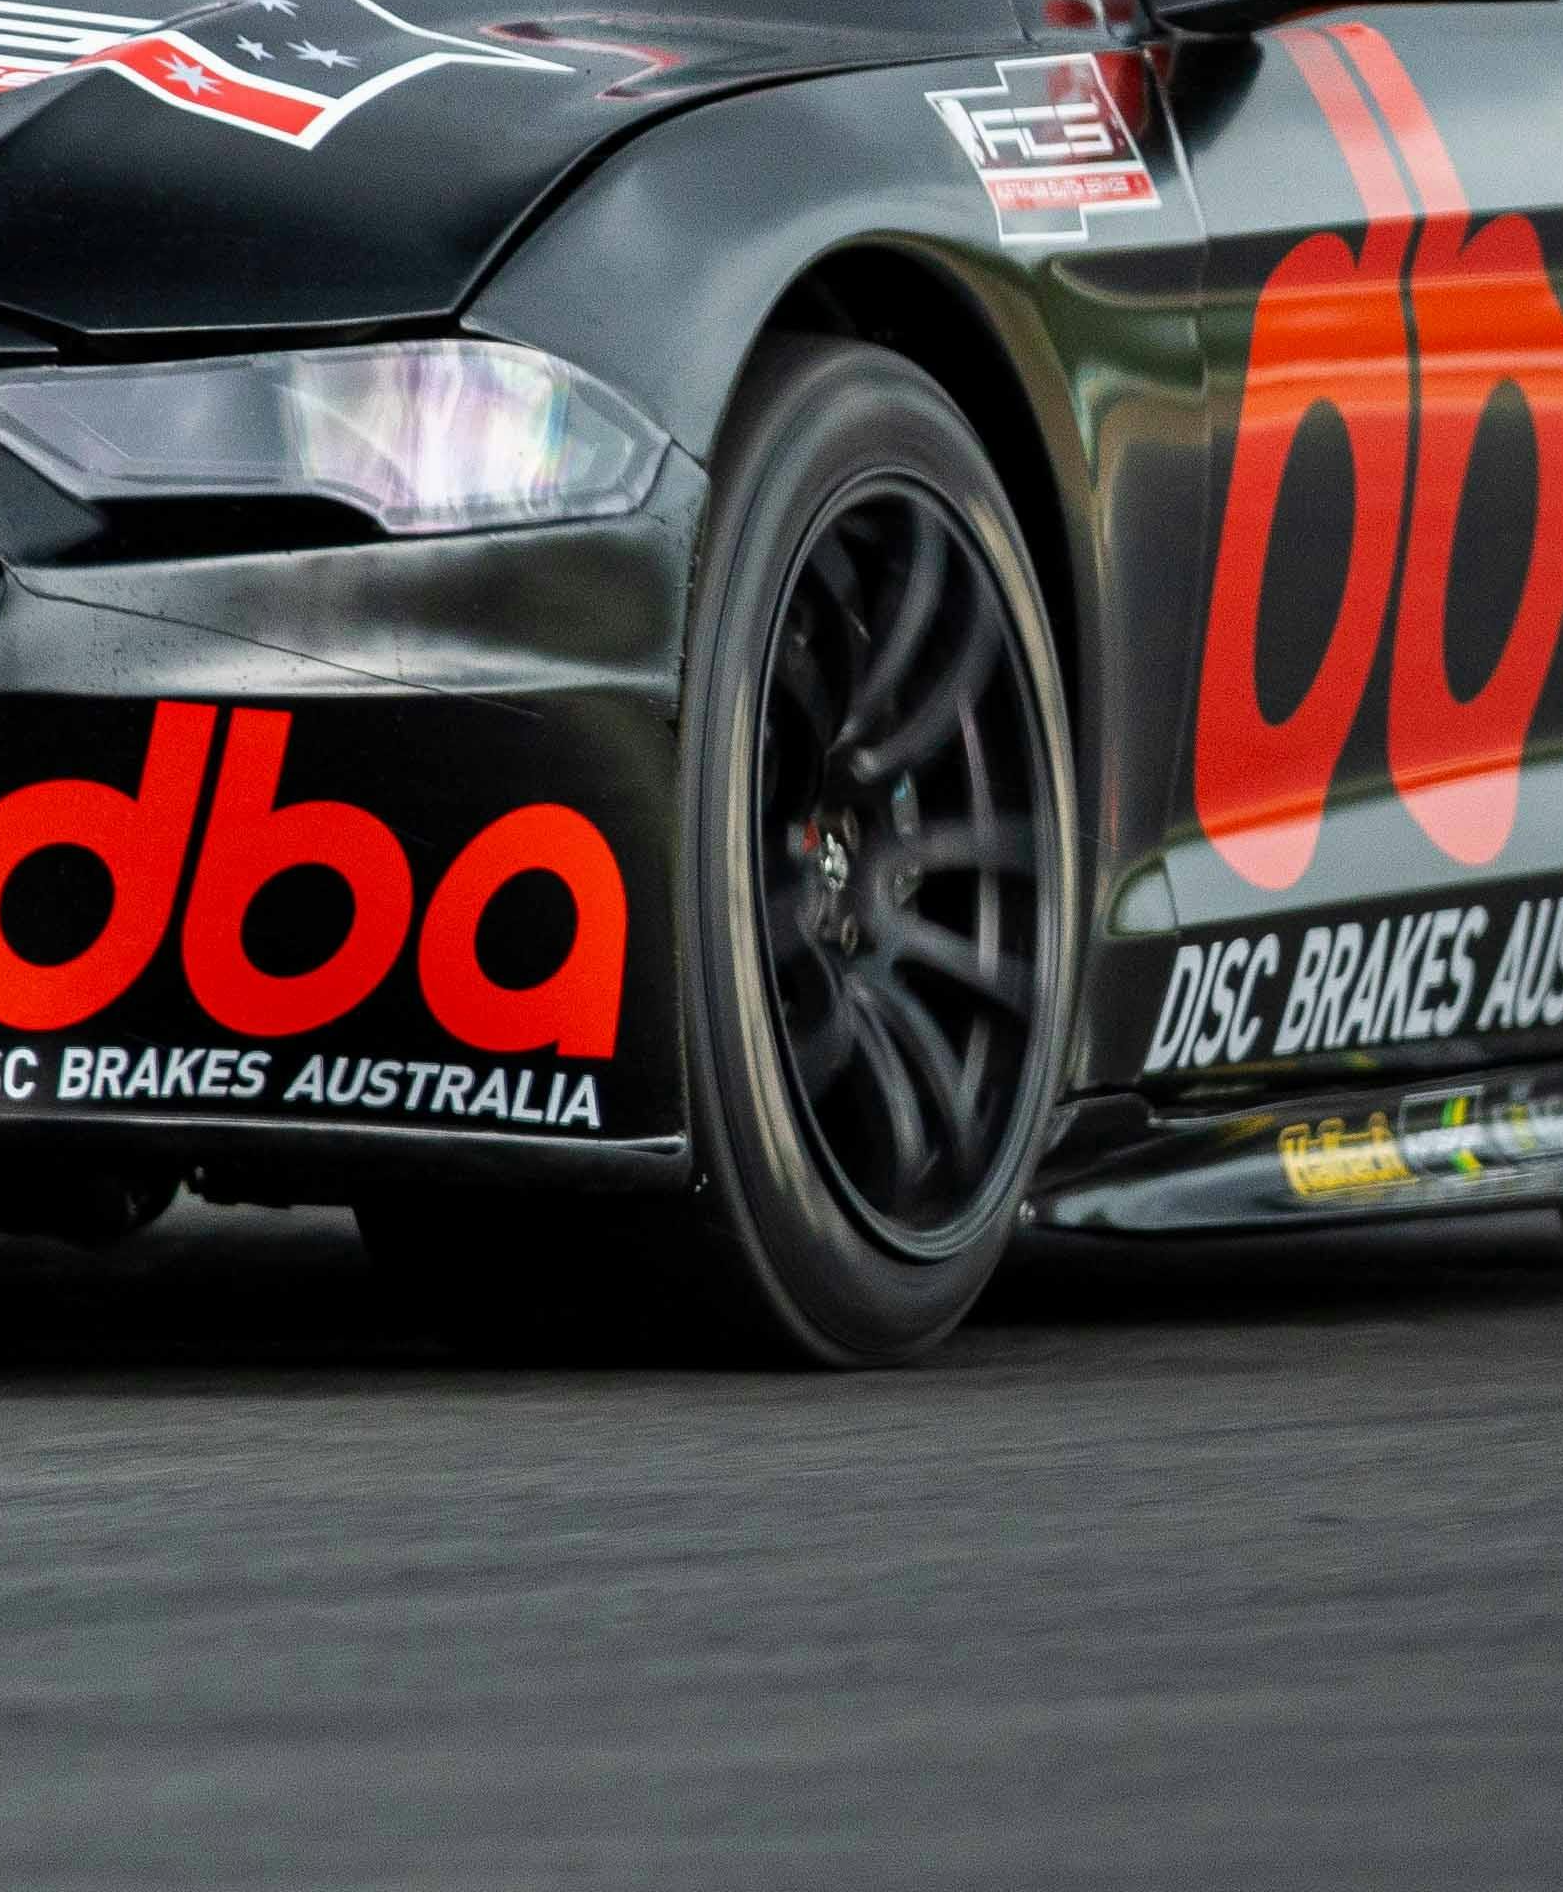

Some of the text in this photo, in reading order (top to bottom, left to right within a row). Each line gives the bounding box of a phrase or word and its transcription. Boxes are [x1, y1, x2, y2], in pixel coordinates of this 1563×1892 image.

[1143, 934, 1280, 1073] DISC
[1274, 905, 1489, 1055] BRAKES
[56, 1046, 272, 1100] BRAKES
[283, 1054, 602, 1128] AUSTRALIA
